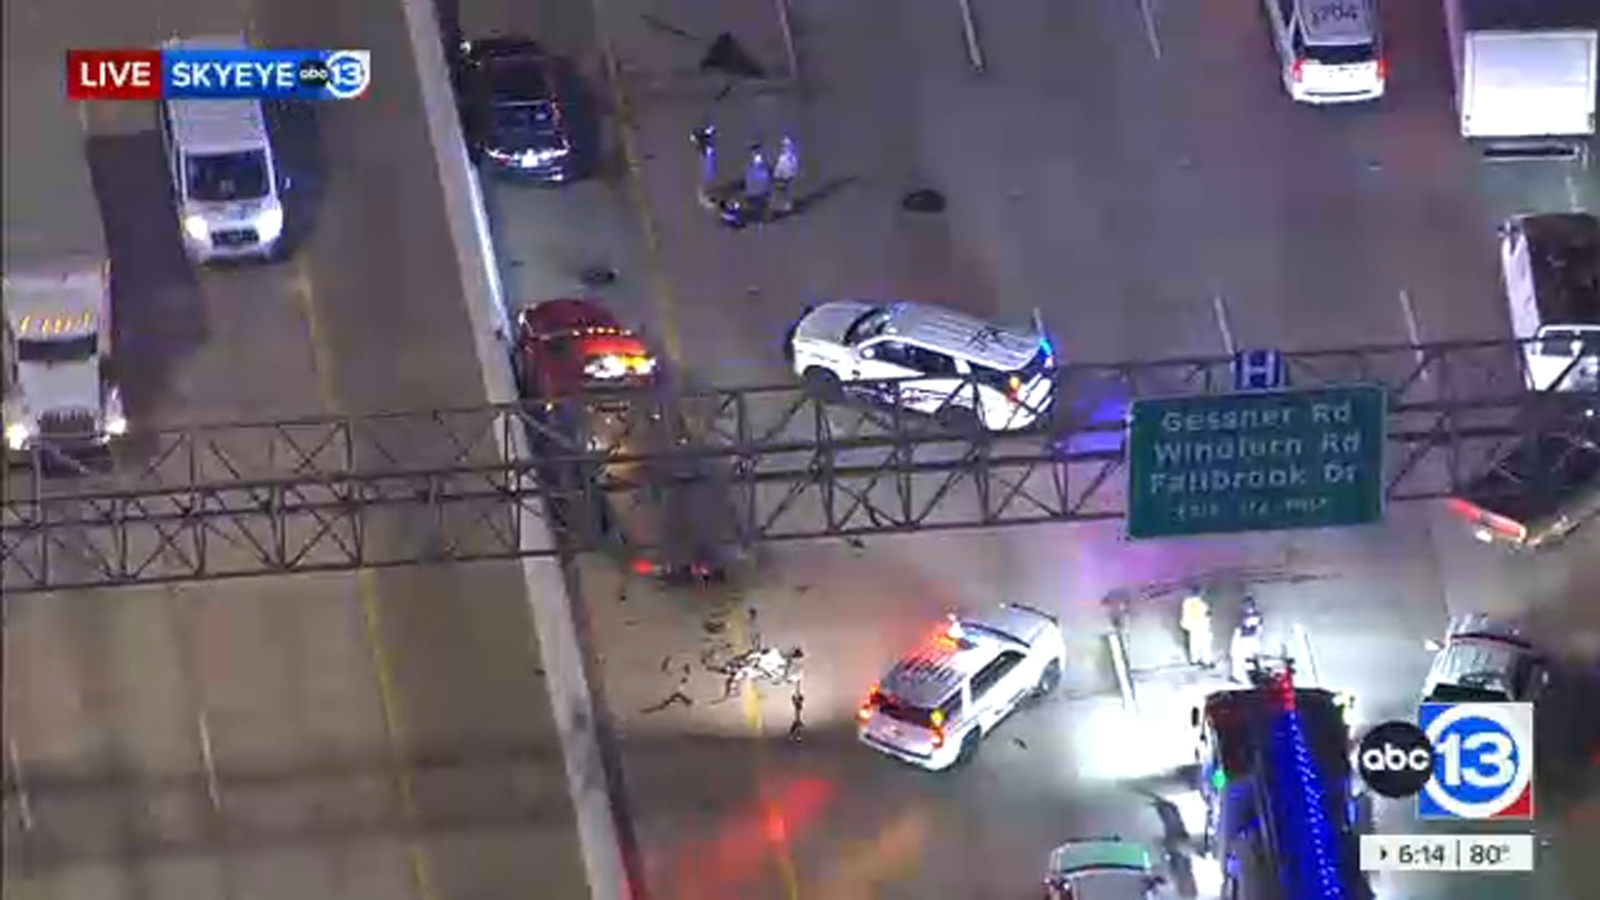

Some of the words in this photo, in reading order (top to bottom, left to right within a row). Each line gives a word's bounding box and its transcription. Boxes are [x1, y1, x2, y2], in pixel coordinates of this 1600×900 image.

[1241, 350, 1275, 388] H
[1162, 406, 1293, 433] Gessner
[1311, 401, 1351, 424] Rd
[1321, 431, 1361, 454] Rd
[1150, 464, 1306, 495] Fallbrook
[1323, 463, 1358, 483] Dr
